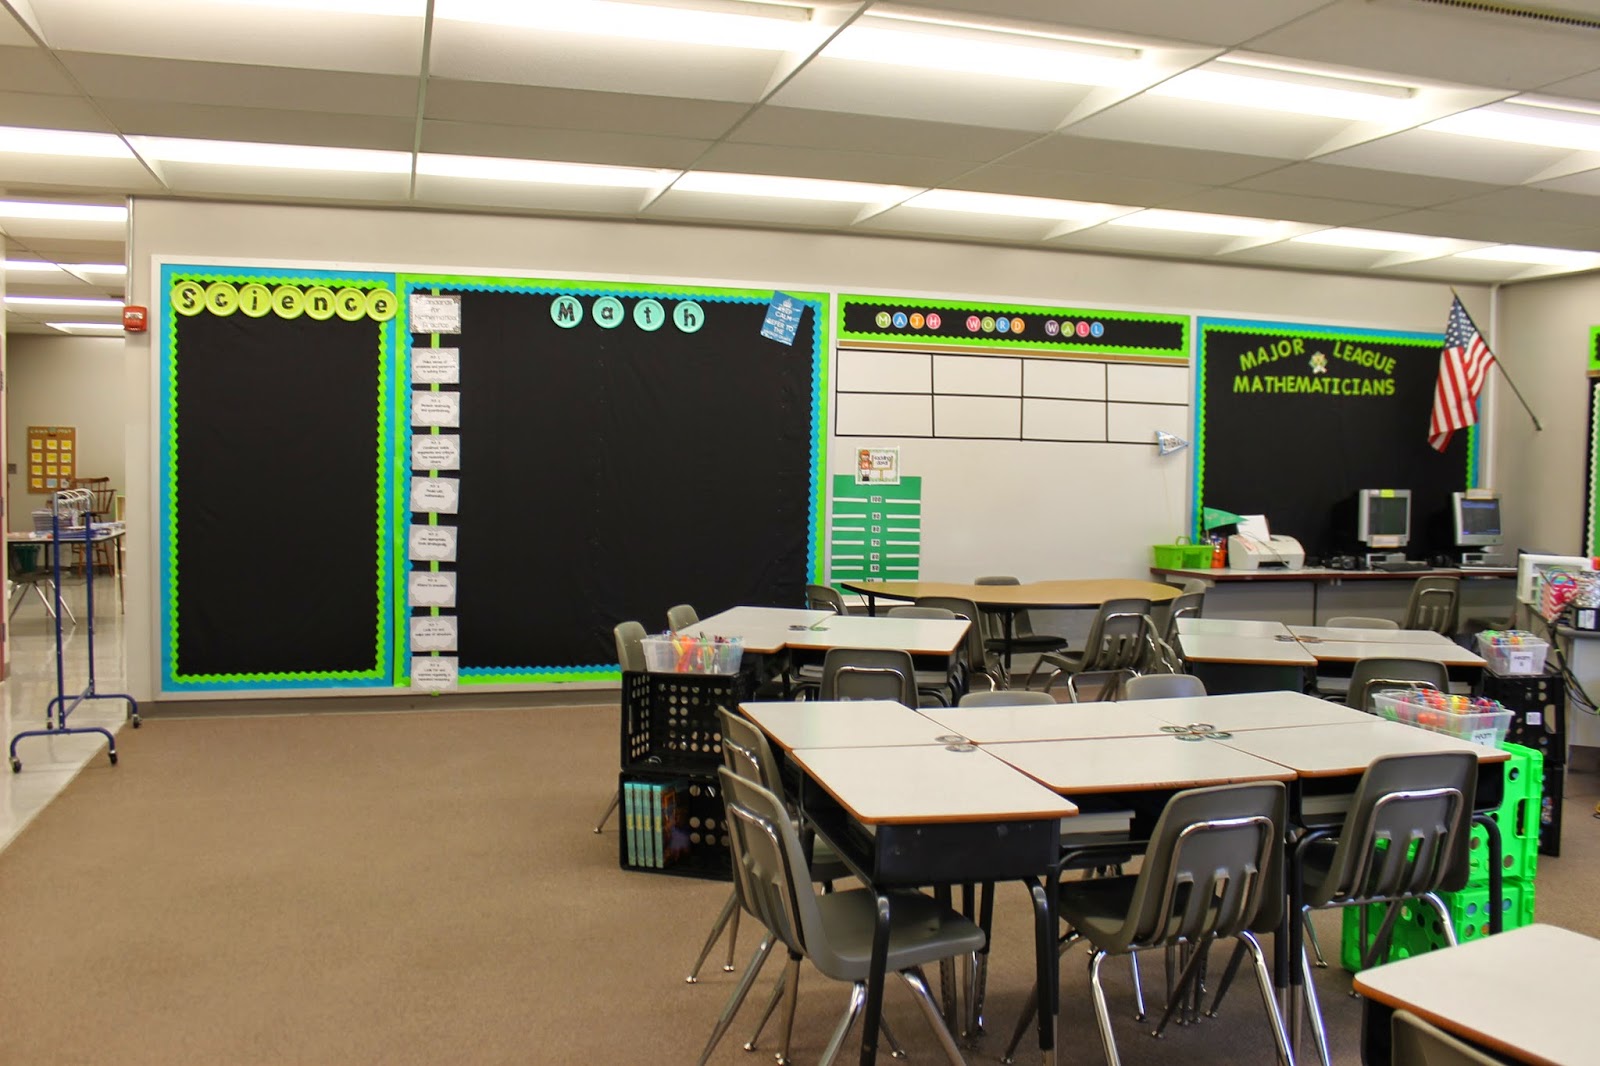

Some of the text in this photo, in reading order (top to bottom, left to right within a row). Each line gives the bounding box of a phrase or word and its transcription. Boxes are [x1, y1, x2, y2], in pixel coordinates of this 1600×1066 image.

[180, 286, 390, 316] Science
[556, 299, 700, 328] Math
[876, 313, 1103, 336] MATH WORD WALL
[1239, 338, 1396, 375] MAJOR LEAGUE
[1233, 375, 1396, 396] MATHEMATICIANS
